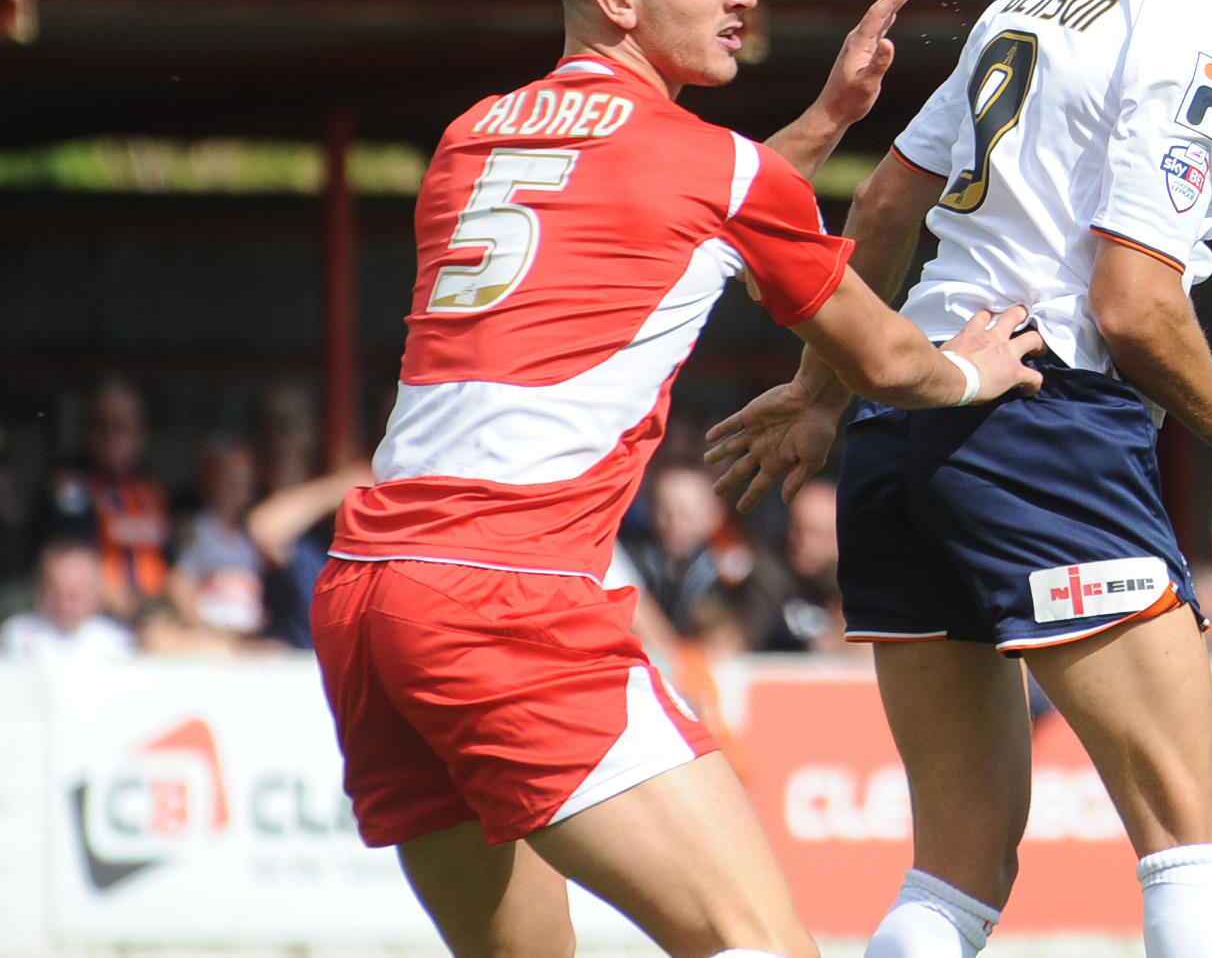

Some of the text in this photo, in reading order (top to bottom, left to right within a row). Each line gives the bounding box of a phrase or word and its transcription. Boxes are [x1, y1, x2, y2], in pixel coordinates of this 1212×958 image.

[471, 88, 634, 137] ALDRED
[937, 29, 1039, 215] 9
[1163, 157, 1188, 178] sky
[426, 148, 581, 313] 5
